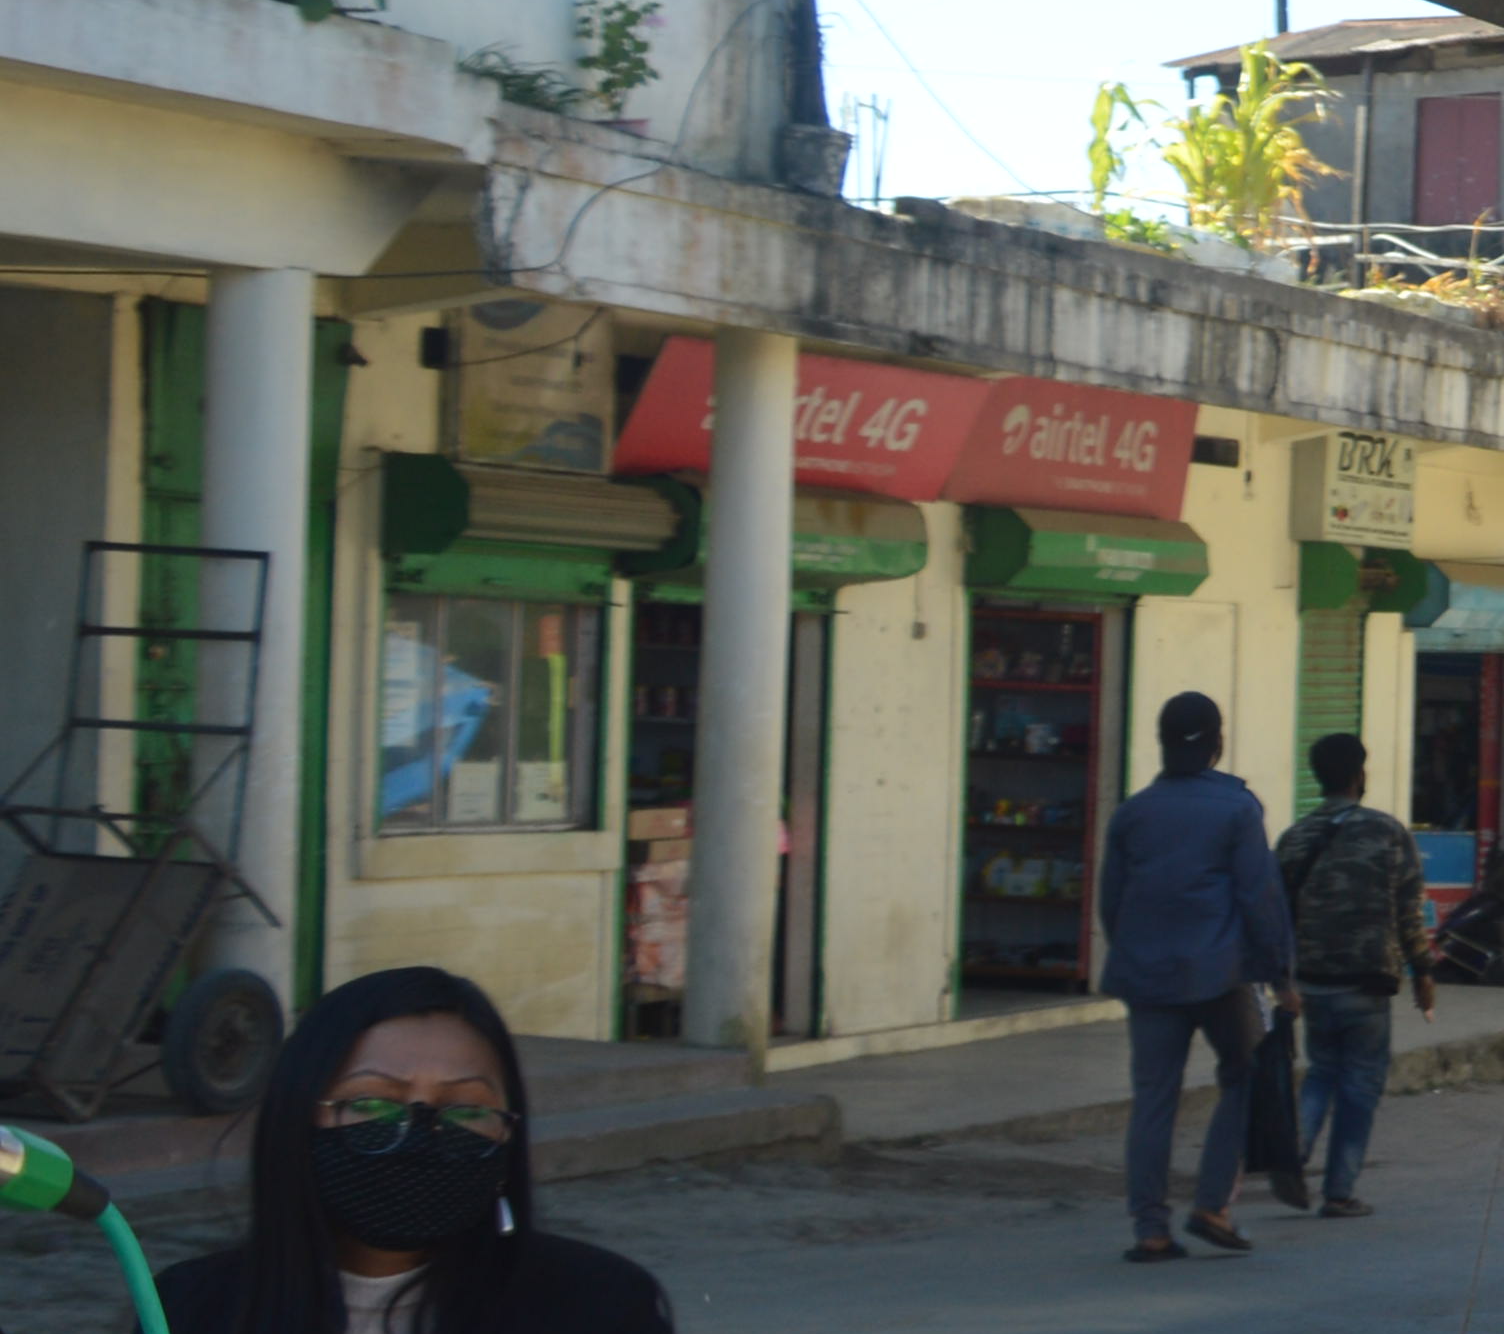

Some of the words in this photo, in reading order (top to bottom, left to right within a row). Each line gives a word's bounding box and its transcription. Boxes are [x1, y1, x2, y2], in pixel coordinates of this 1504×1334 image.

[858, 398, 928, 451] 4G
[1029, 403, 1109, 465] airtel
[1114, 421, 1158, 472] 4G
